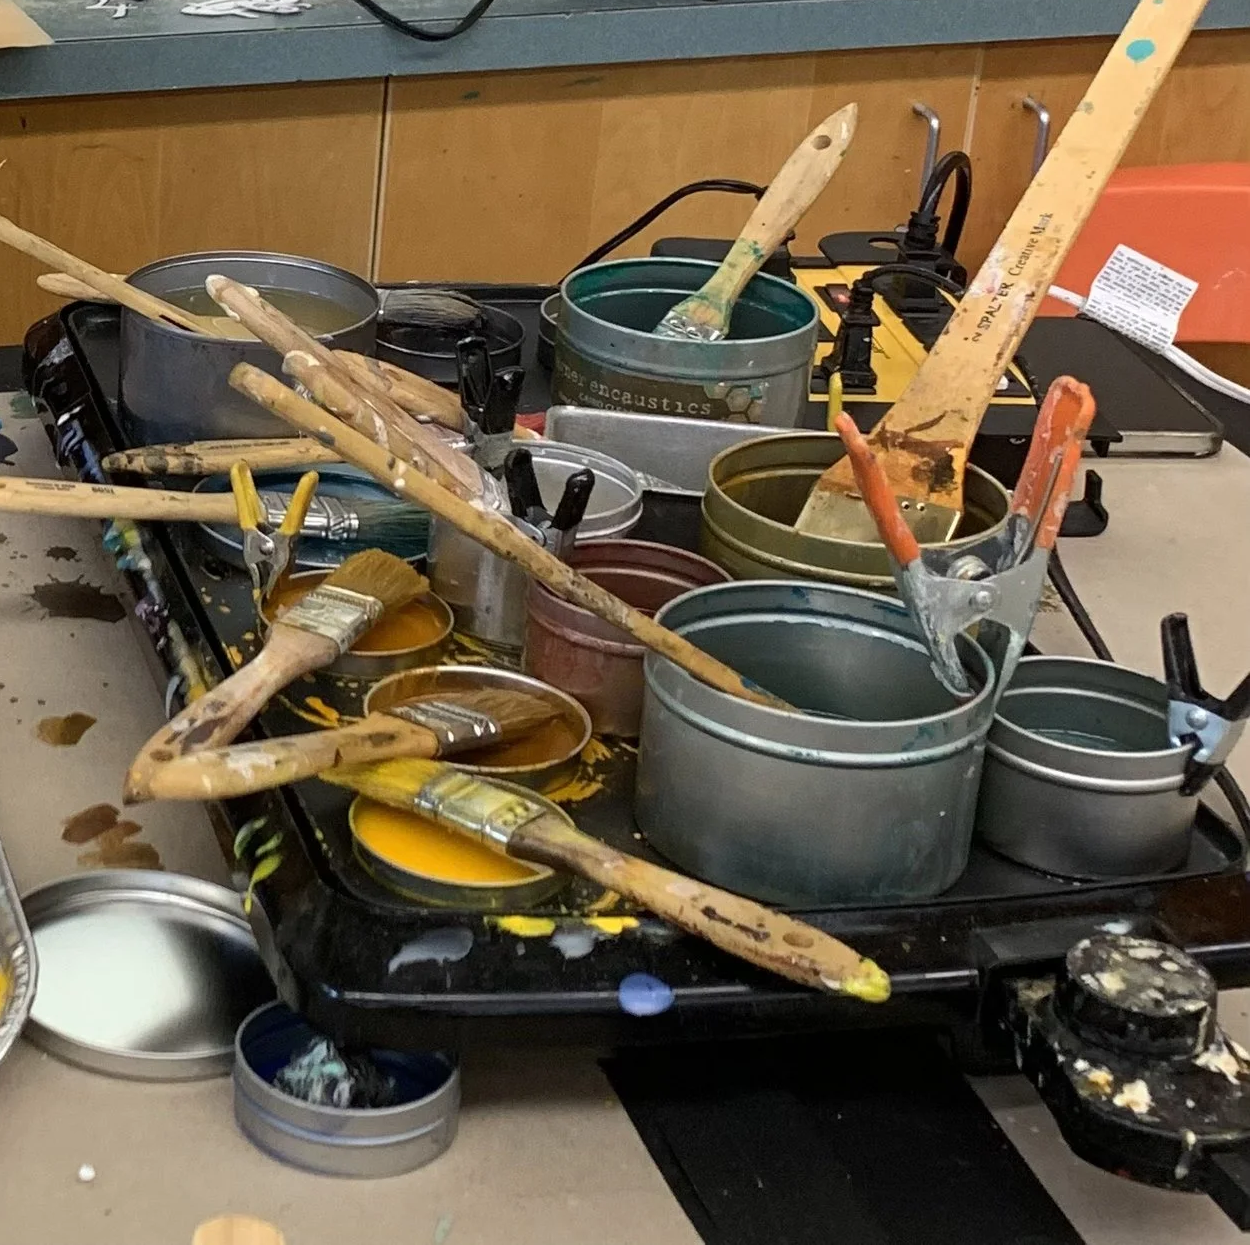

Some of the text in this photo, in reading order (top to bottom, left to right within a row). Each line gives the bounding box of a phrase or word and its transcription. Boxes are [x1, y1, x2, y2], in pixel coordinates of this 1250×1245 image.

[1008, 237, 1038, 276] Creative
[1030, 212, 1053, 235] Mrk
[589, 381, 711, 415] encaustics
